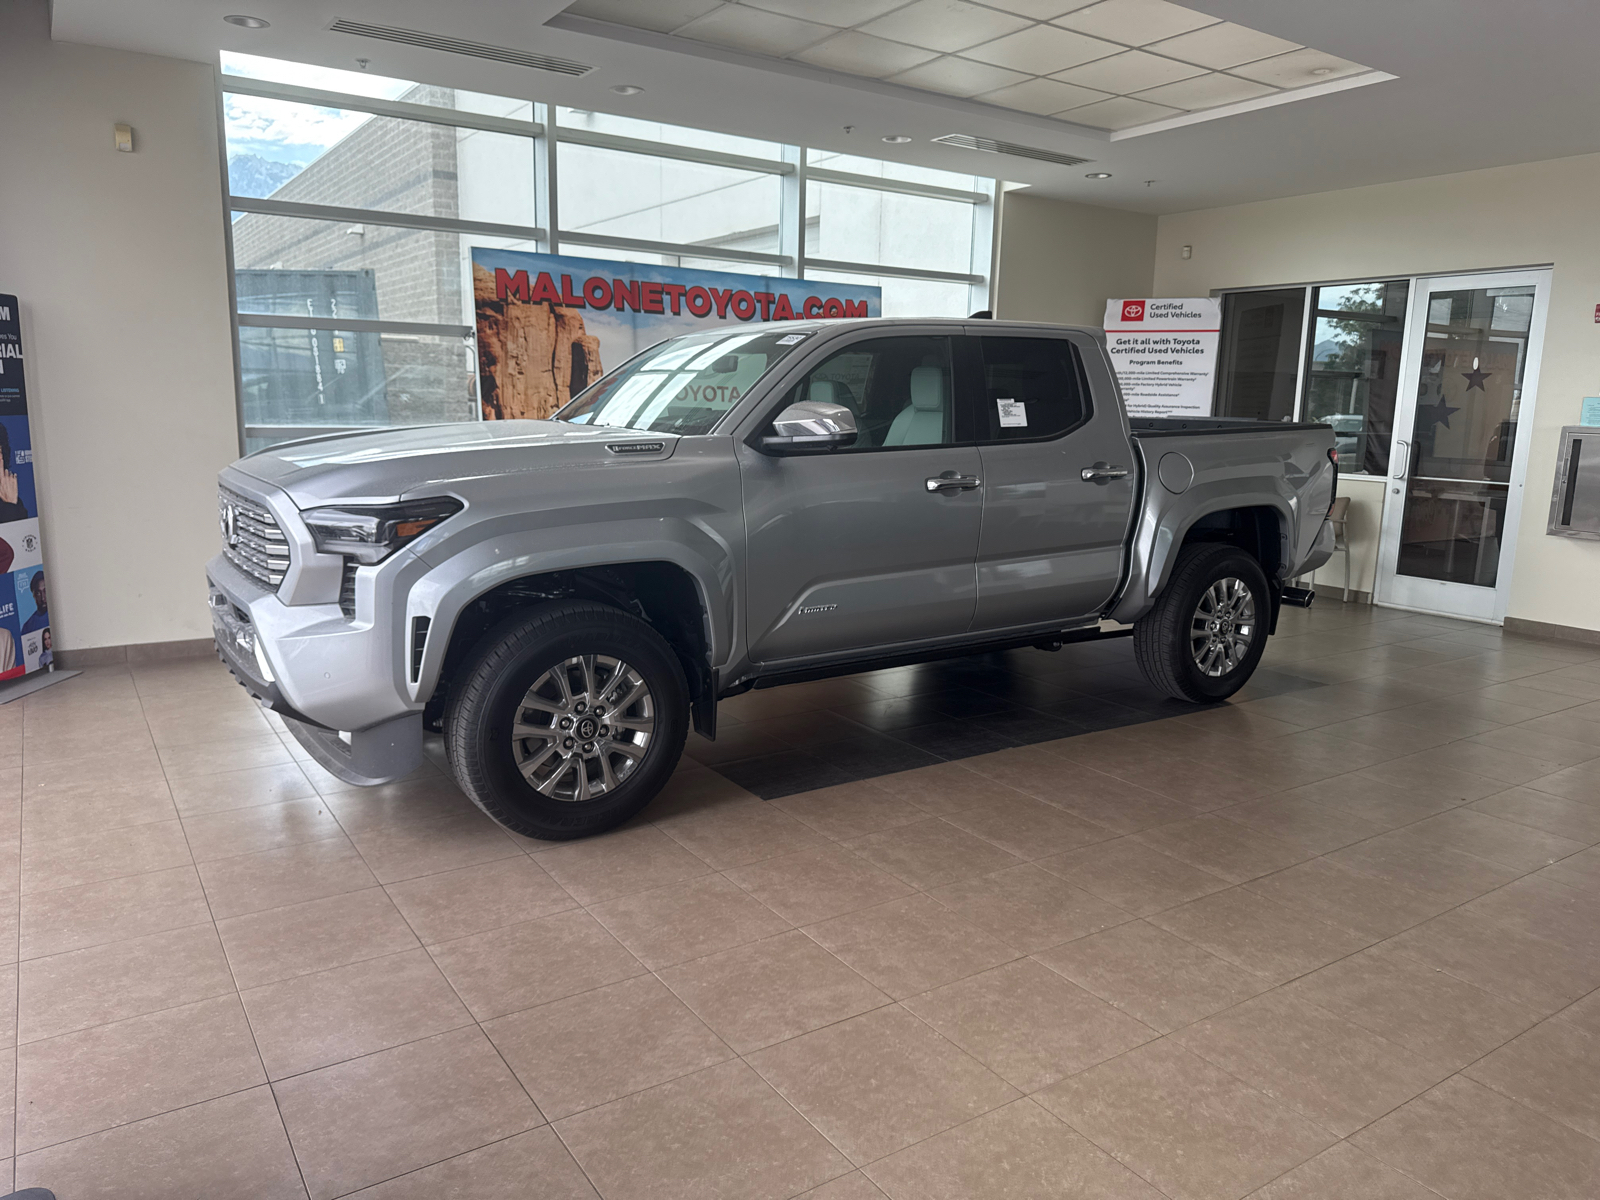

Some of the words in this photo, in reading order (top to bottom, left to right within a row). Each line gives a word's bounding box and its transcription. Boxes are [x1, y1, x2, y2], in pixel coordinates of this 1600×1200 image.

[494, 267, 868, 320] MALONETOYOTA.COM
[7, 333, 18, 341] You
[1172, 338, 1200, 347] Toyota
[676, 385, 741, 403] OYOTA
